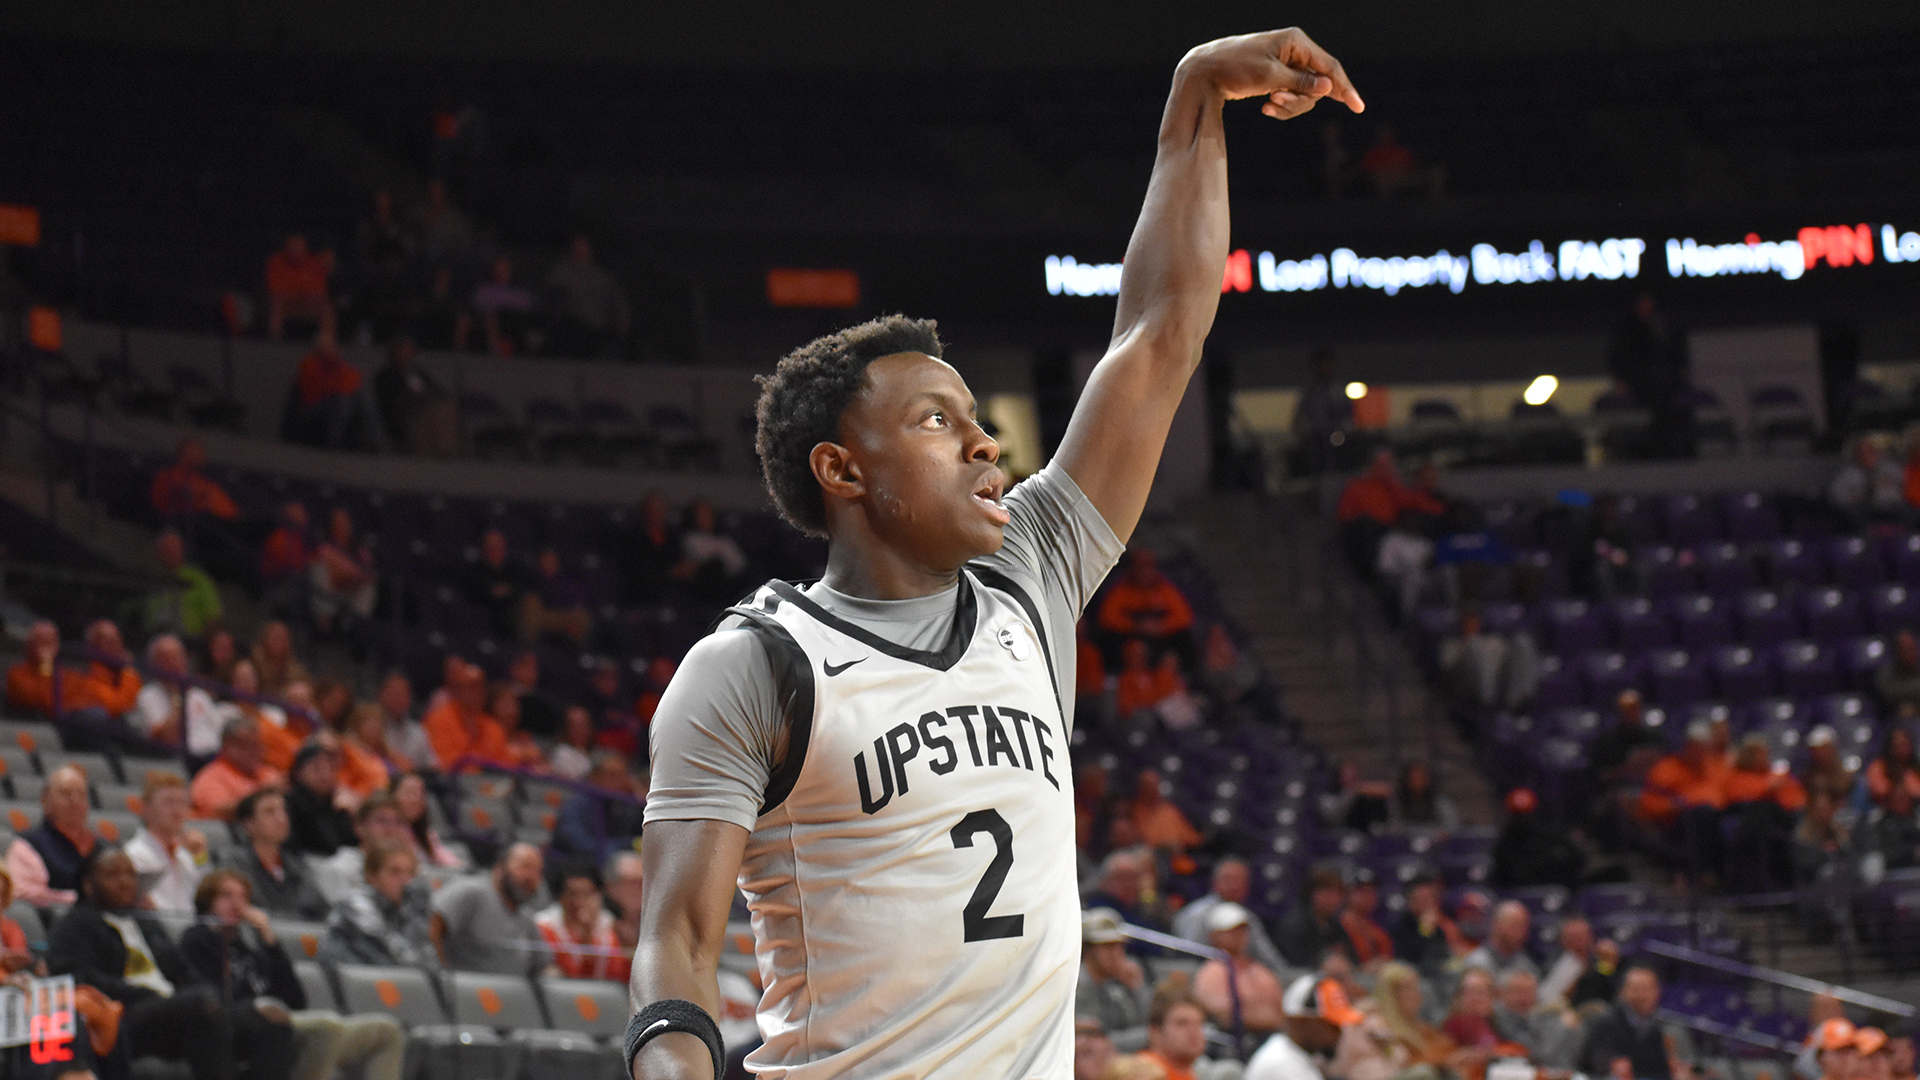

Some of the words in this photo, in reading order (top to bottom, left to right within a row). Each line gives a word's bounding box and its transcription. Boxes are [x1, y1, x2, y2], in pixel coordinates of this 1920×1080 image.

[1258, 251, 1329, 292] Lost
[1331, 248, 1469, 296] Property
[1471, 241, 1557, 284] Back
[1558, 238, 1646, 281] FAST
[1881, 224, 1920, 262] Lo
[853, 705, 1061, 815] UPSTATE
[950, 808, 1025, 943] 2
